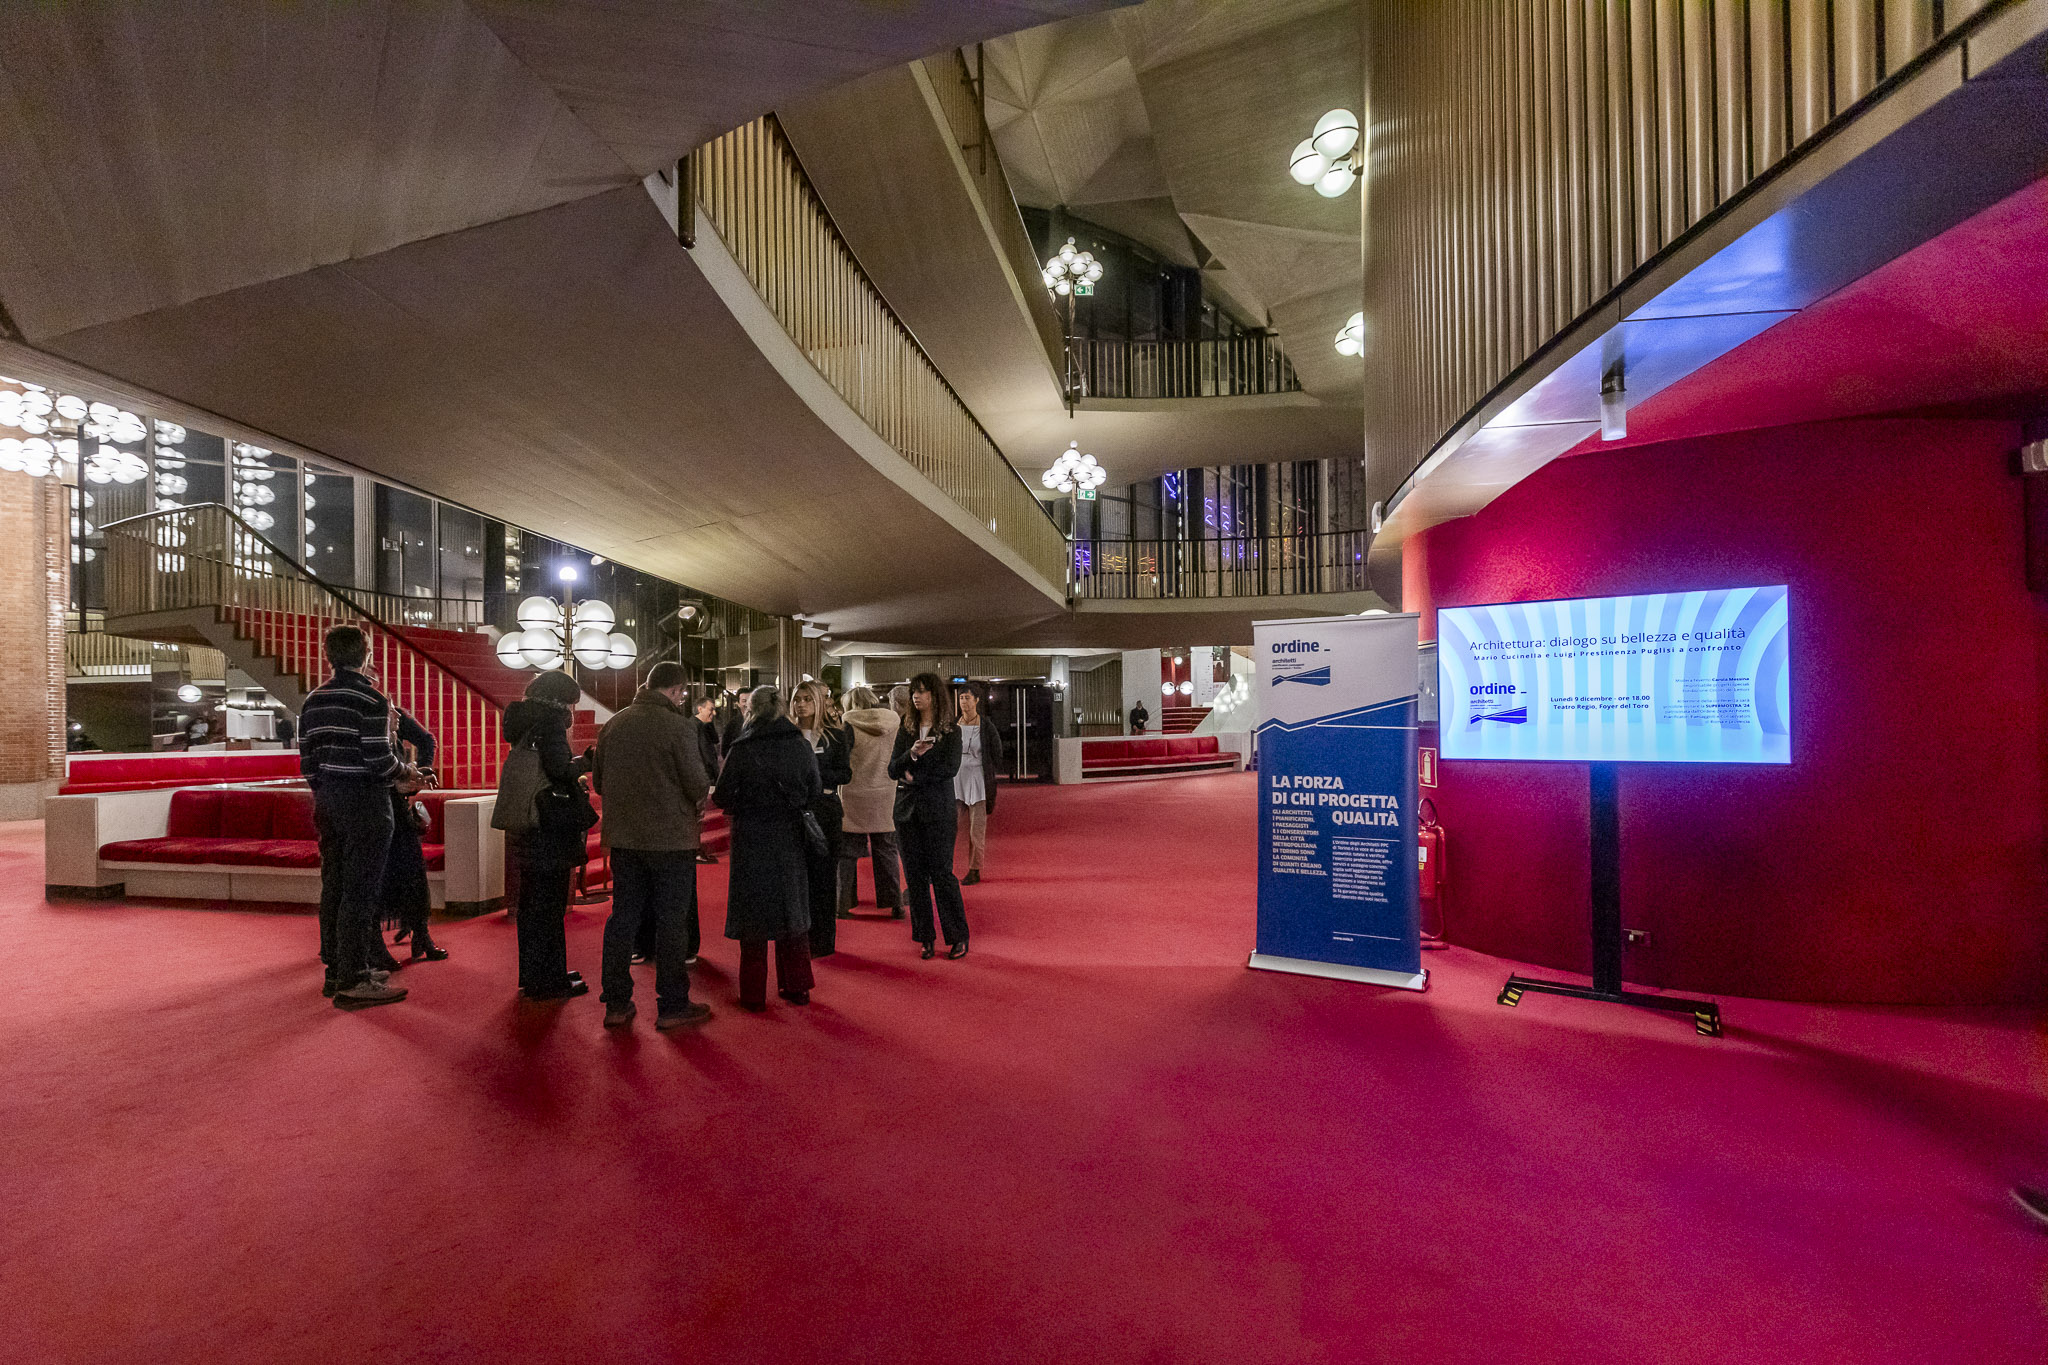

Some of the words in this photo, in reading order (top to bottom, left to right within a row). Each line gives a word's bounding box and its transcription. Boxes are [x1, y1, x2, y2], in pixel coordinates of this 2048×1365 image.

[1470, 639, 1546, 650] Architettura:
[1550, 636, 1597, 648] dialogo
[1601, 636, 1616, 645] su
[1621, 632, 1676, 644] bellezza
[1681, 632, 1689, 641] e
[1694, 627, 1745, 642] qualità
[1272, 640, 1319, 653] ordine
[1641, 647, 1675, 655] Puglisi
[1470, 682, 1516, 695] ordine
[1272, 776, 1291, 788] LA
[1294, 776, 1344, 790] FORZA
[1272, 792, 1287, 804] DI
[1290, 792, 1315, 806] CHI
[1318, 794, 1399, 808] PROGETTA
[1332, 810, 1399, 826] QUALITÀ
